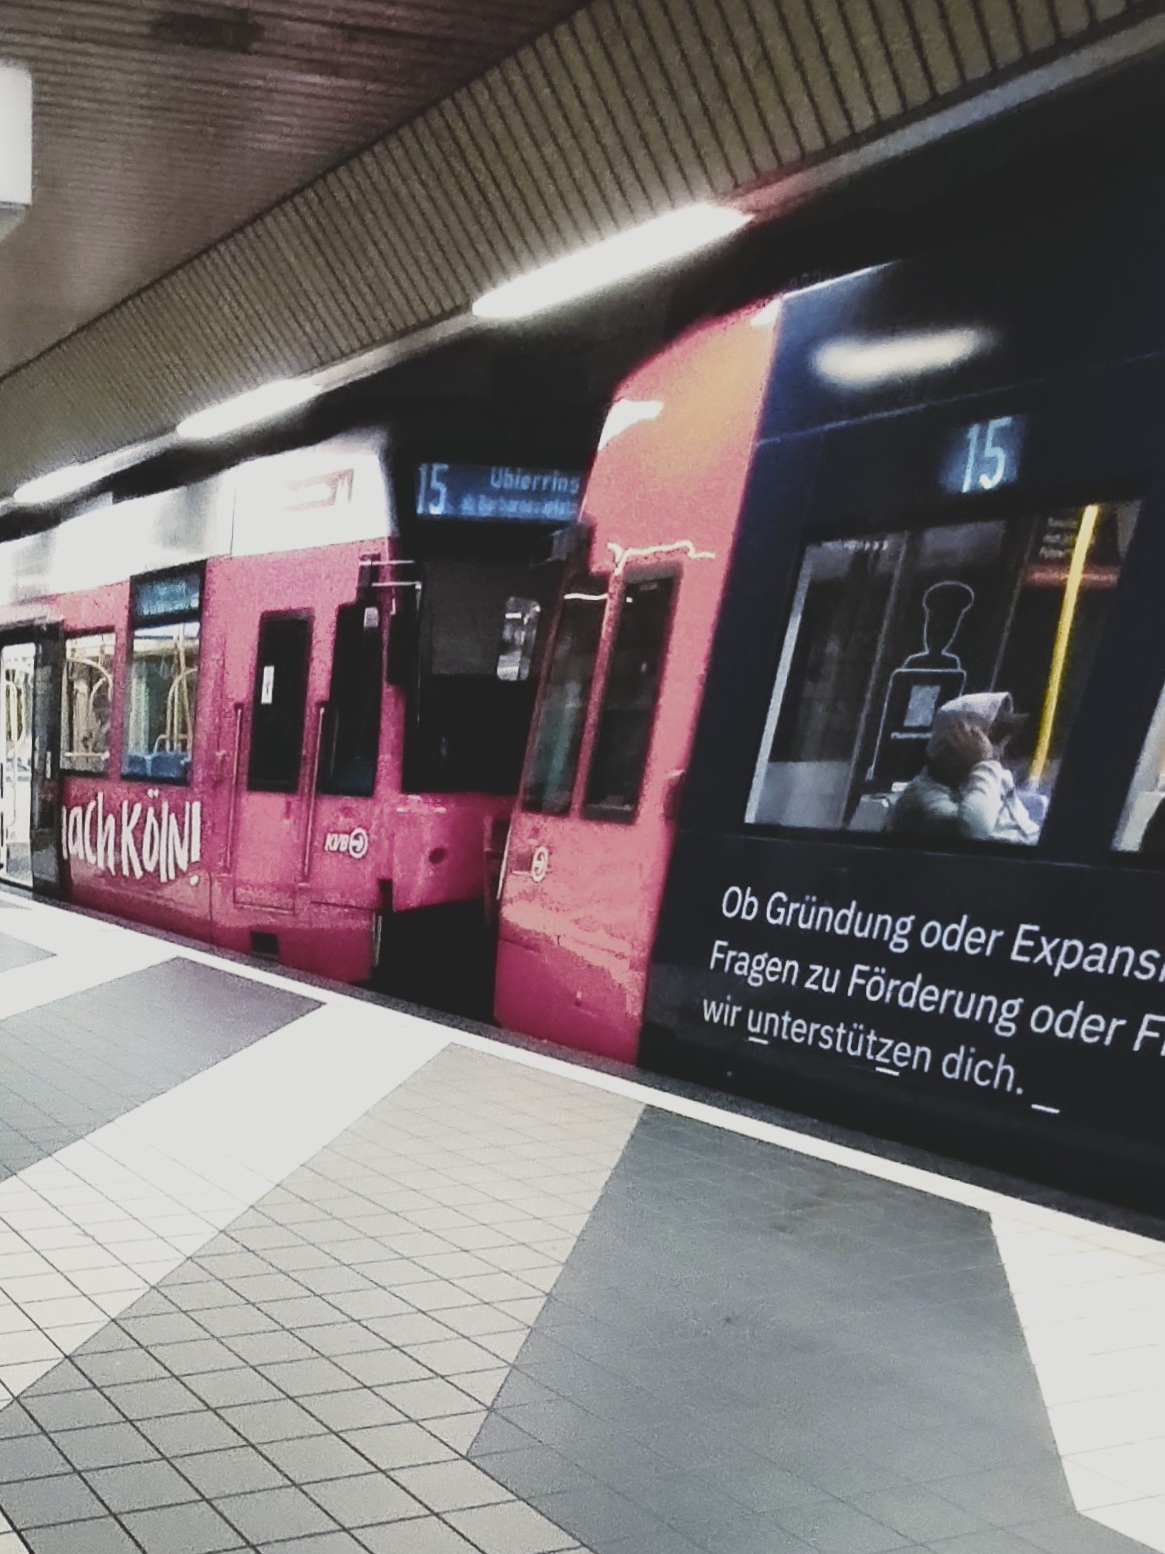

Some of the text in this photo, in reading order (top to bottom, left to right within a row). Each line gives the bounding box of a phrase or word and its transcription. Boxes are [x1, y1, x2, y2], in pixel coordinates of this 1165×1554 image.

[417, 463, 449, 515] 15
[962, 416, 1012, 493] 15
[722, 886, 759, 921] Ob
[766, 891, 915, 953] Gründung
[920, 915, 1004, 957] oder
[709, 940, 799, 987] Fragen
[804, 964, 840, 994] zu
[847, 964, 1024, 1038] Förderung
[1030, 1001, 1126, 1047] oder
[703, 995, 1024, 1095] wir unterstützen dich.
